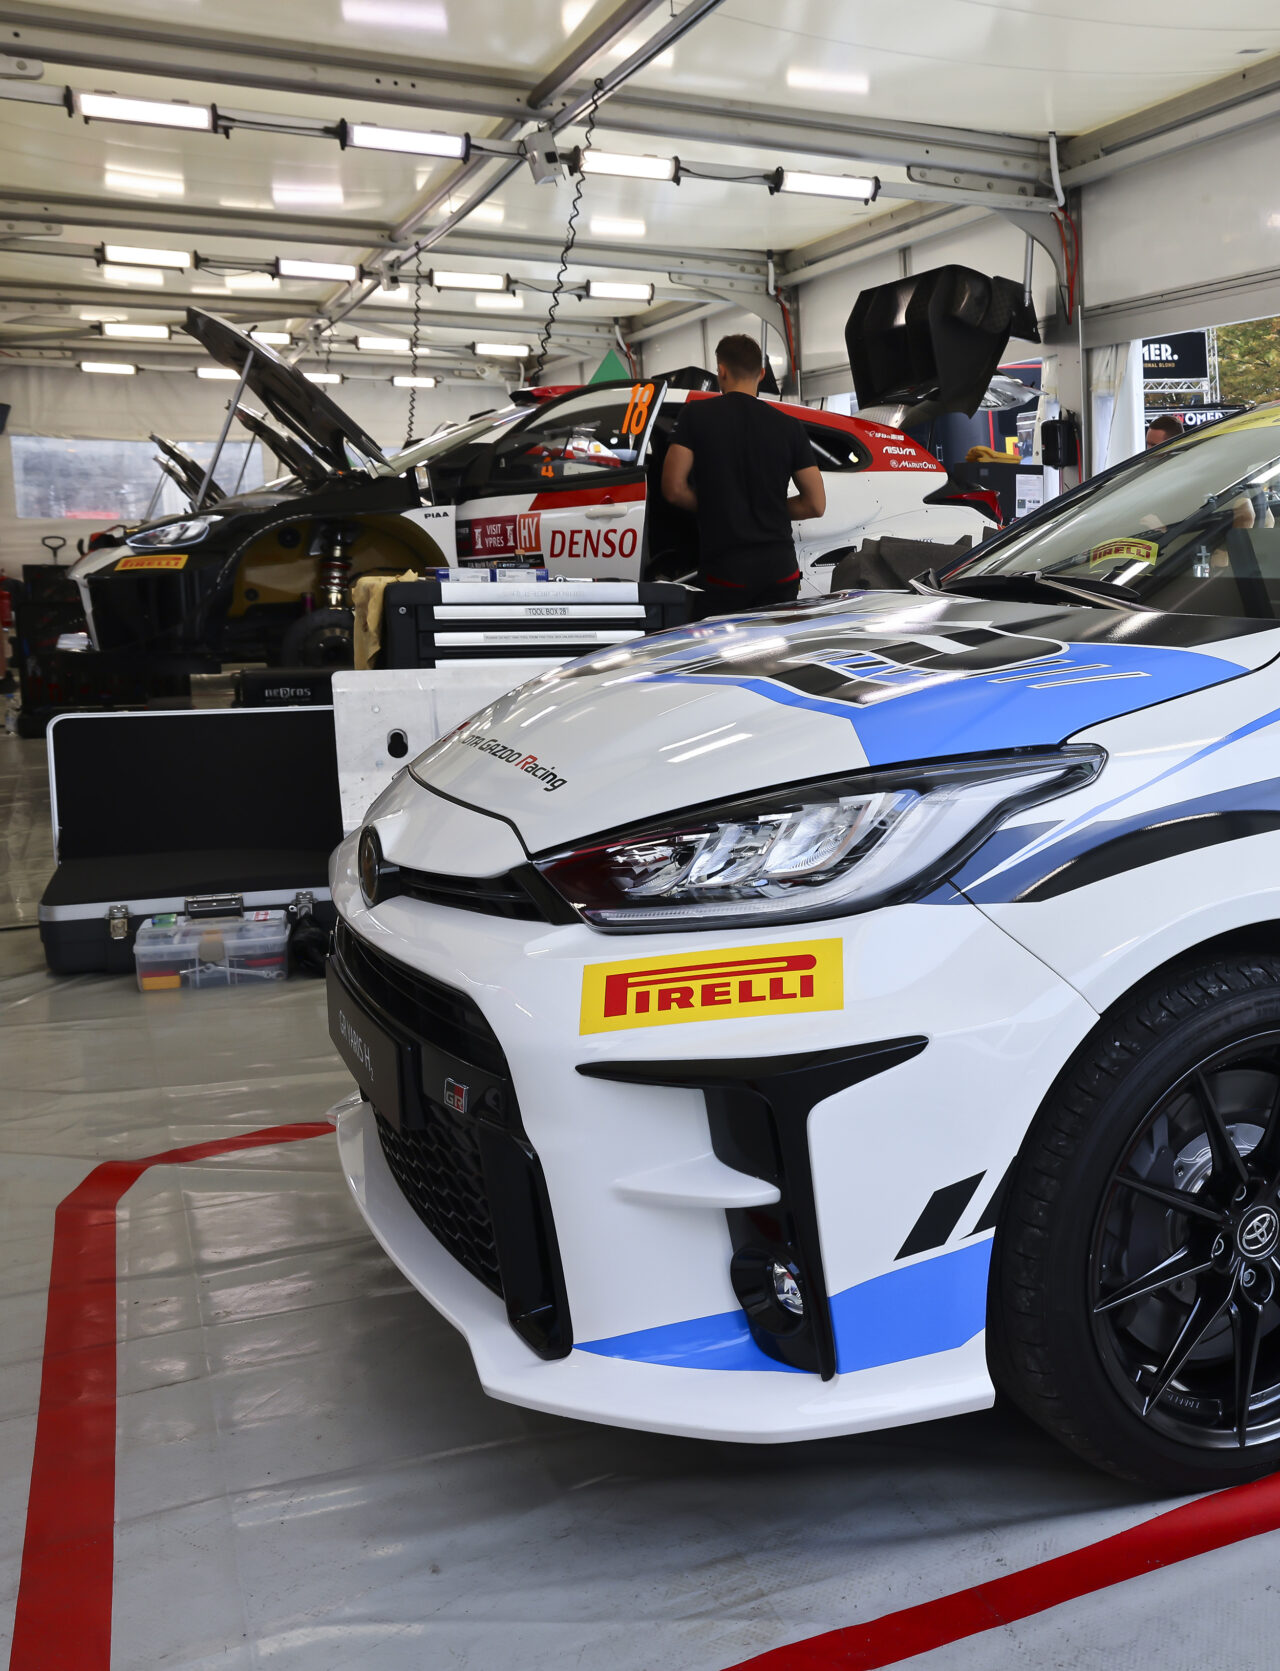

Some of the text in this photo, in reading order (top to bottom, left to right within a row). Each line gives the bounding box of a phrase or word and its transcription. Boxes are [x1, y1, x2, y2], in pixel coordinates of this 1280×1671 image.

[621, 383, 655, 435] 18
[424, 511, 450, 520] PIAA
[486, 523, 502, 535] VISIT
[520, 517, 538, 549] HY
[485, 535, 504, 549] YPRES
[550, 528, 638, 559] DENSO
[1092, 540, 1152, 562] PIRELLI
[528, 608, 544, 616] TOOL
[545, 608, 559, 616] BOX
[478, 739, 522, 763] GAZOO
[514, 754, 568, 792] Racing
[604, 954, 817, 1018] PIRELLI
[445, 1092, 464, 1111] GR
